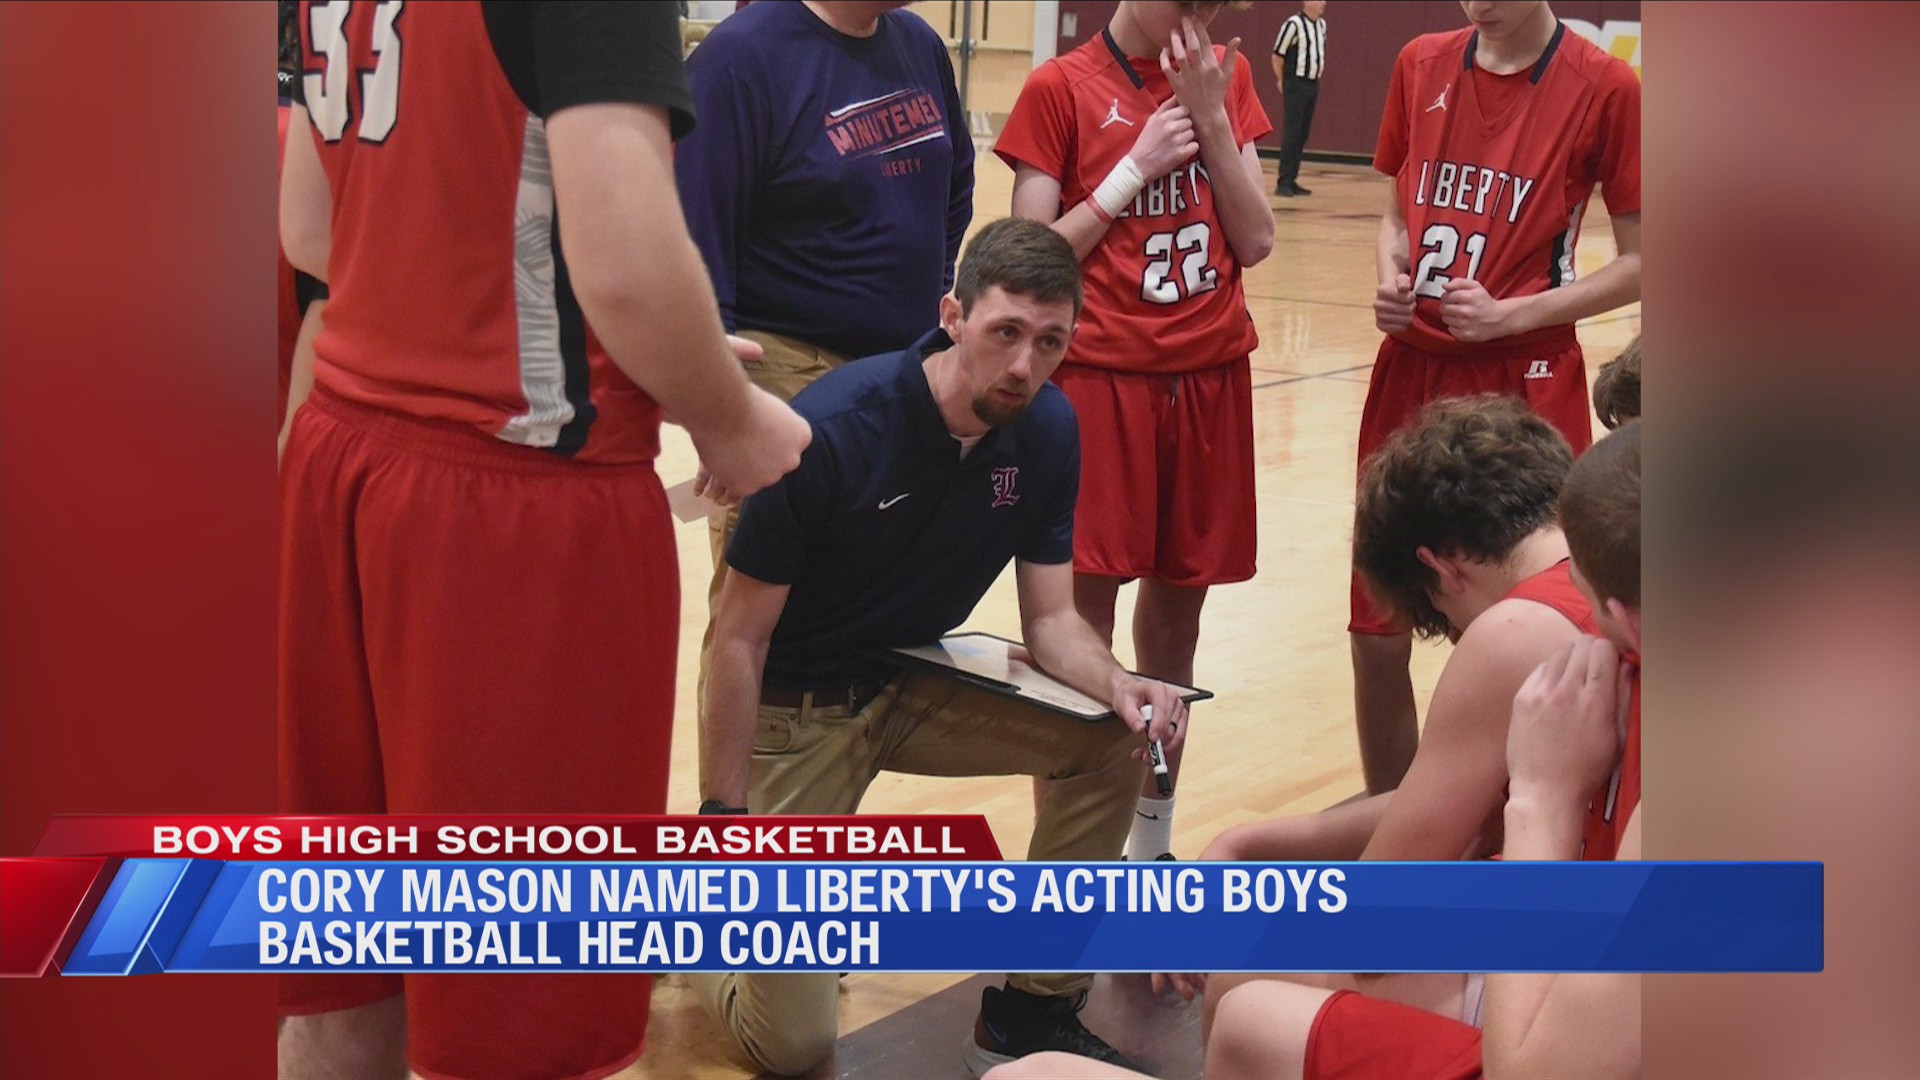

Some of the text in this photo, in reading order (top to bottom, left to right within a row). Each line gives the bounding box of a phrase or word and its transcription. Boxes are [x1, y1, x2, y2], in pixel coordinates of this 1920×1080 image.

[302, 1, 404, 143] 33
[1415, 161, 1534, 223] LBERTY
[1140, 222, 1217, 304] 22
[1413, 223, 1487, 299] 21
